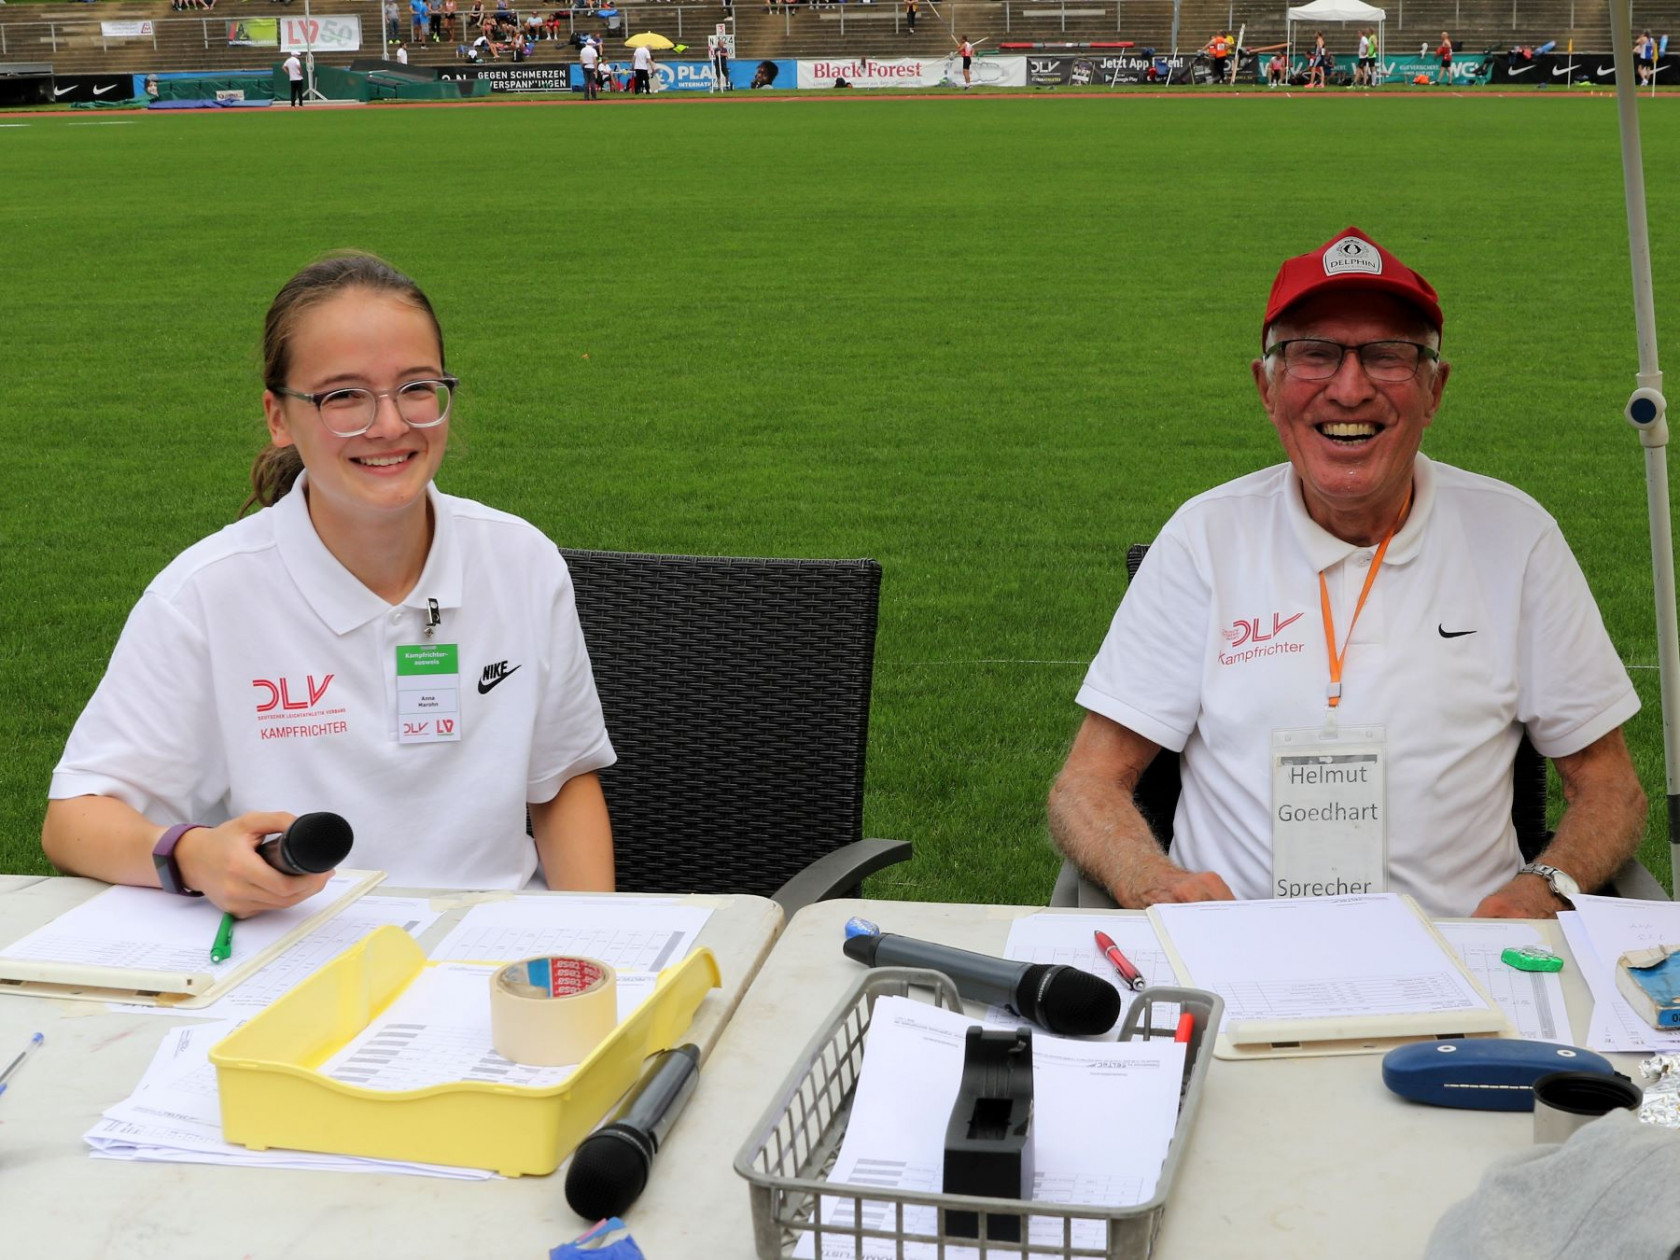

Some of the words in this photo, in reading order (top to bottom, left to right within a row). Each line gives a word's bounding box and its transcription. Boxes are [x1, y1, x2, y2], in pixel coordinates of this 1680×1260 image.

[814, 63, 861, 78] Black
[868, 62, 922, 77] Forest
[1031, 61, 1060, 73] DLV
[1100, 58, 1127, 68] Jetzt
[1129, 58, 1149, 70] App
[1152, 57, 1184, 67] len!
[478, 71, 508, 80] GEGEN
[510, 70, 566, 79] SCHMERZEN
[678, 65, 717, 79] PLA
[490, 80, 566, 89] ERSPANNNGEN
[1330, 259, 1376, 268] DELPHIN
[1232, 612, 1304, 647] DLV
[405, 651, 448, 659] Kampfrichter-
[1218, 641, 1304, 666] Kampfrichter
[483, 660, 508, 680] NIKE
[253, 674, 334, 712] DLV
[261, 721, 347, 739] KAMPFRICHTER
[403, 722, 429, 733] DLV
[1290, 766, 1367, 784] Helmut
[1278, 802, 1378, 822] Goedhart
[1277, 878, 1371, 899] Sprecher
